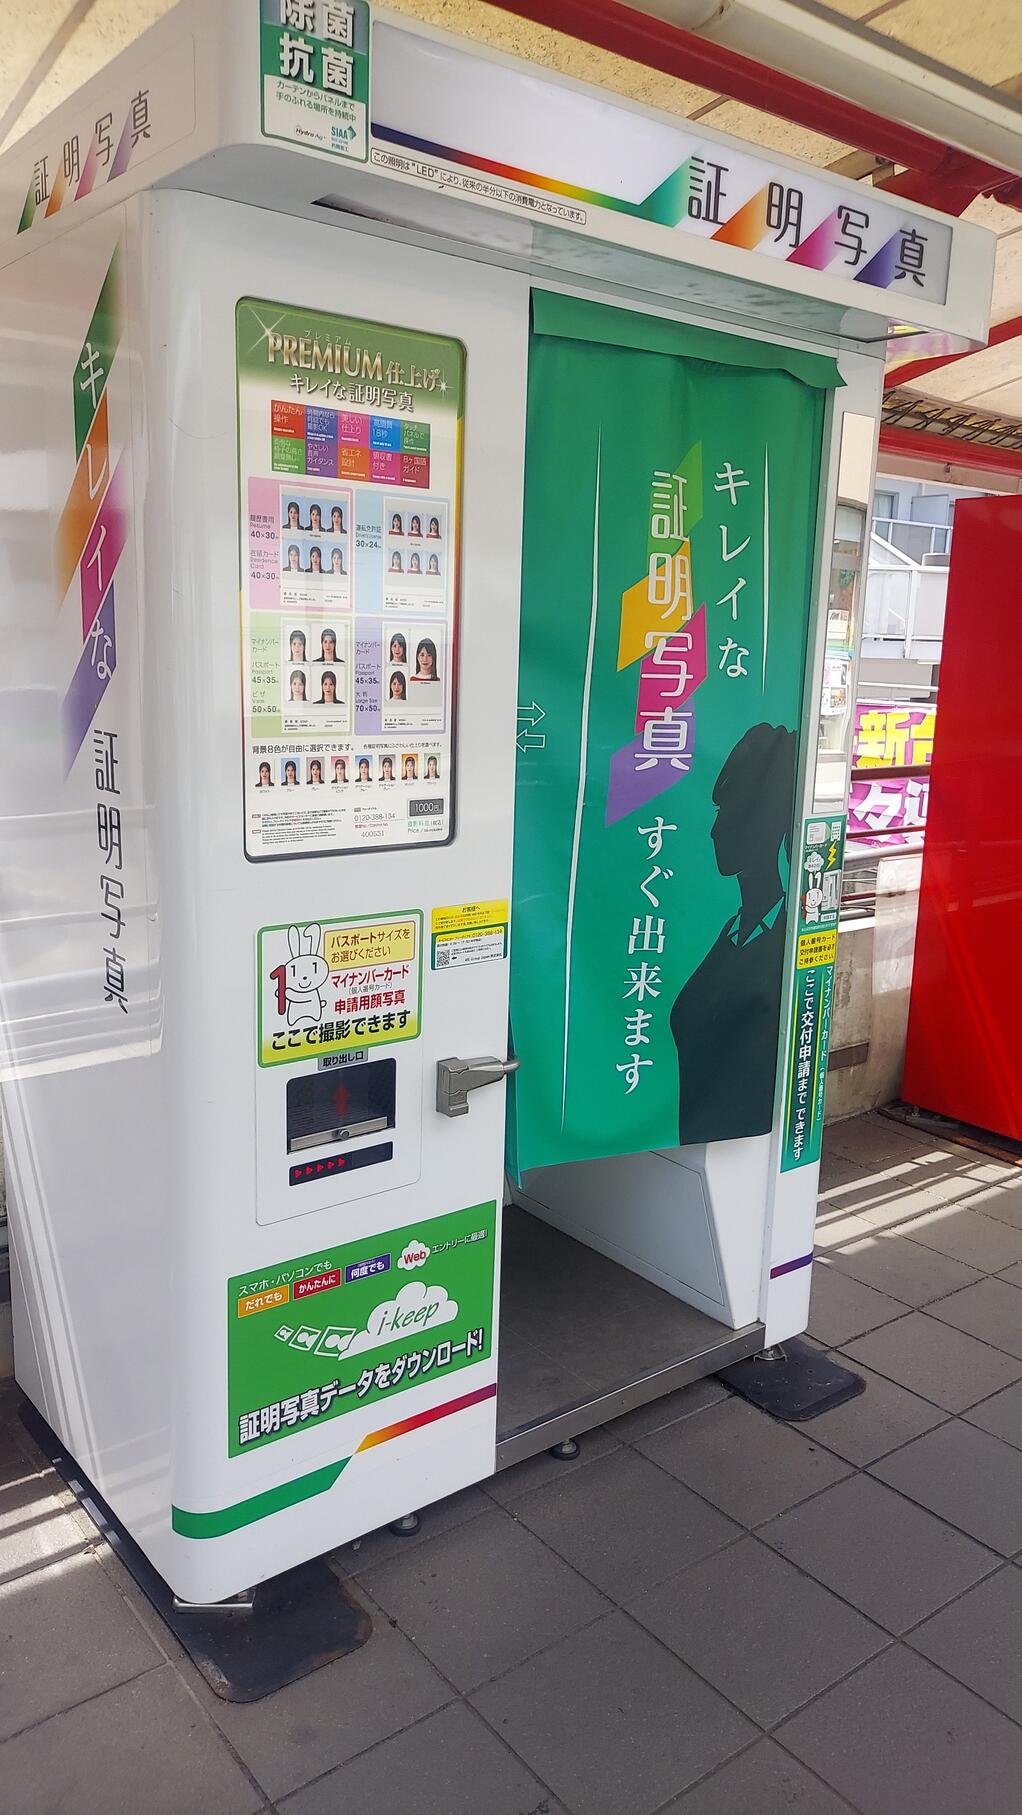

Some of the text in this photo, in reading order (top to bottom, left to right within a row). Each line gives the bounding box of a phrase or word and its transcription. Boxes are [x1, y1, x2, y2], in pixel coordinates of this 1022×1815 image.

[279, 32, 354, 97] 抗菌
[276, 80, 356, 111] カーテンからパネルまで
[33, 90, 151, 206] 証明写真
[331, 126, 349, 140] SIAA
[687, 155, 929, 288] 証明写真
[267, 332, 441, 392] PREMIUM 仕上げ
[290, 373, 415, 413] キレイな証明写真
[307, 457, 334, 466] ガイダンス
[80, 342, 119, 681] キレイな
[714, 462, 750, 678] キレイな
[634, 470, 694, 771] 証明写真
[93, 729, 128, 1014] 証明写真
[330, 928, 410, 948] パスポートサイズを
[331, 946, 392, 964] お選びください
[615, 816, 678, 1095] すぐ出来ます
[331, 964, 410, 988] マイナンバーカード
[334, 990, 406, 1014] 申請用顔写真
[821, 966, 834, 1063] マイナンバーカード
[272, 1010, 411, 1050] ここで撮影できます
[322, 1051, 364, 1067] 取り出し口
[351, 1262, 384, 1279] 何度でも
[404, 1250, 427, 1264] Web
[239, 1261, 332, 1296] スマホ・パソコンでも
[298, 1275, 336, 1294] かんたんに
[245, 1292, 283, 1310] だれでも
[377, 1302, 440, 1335] i-keep
[239, 1328, 484, 1444] 証明写真データをダウンロード!
